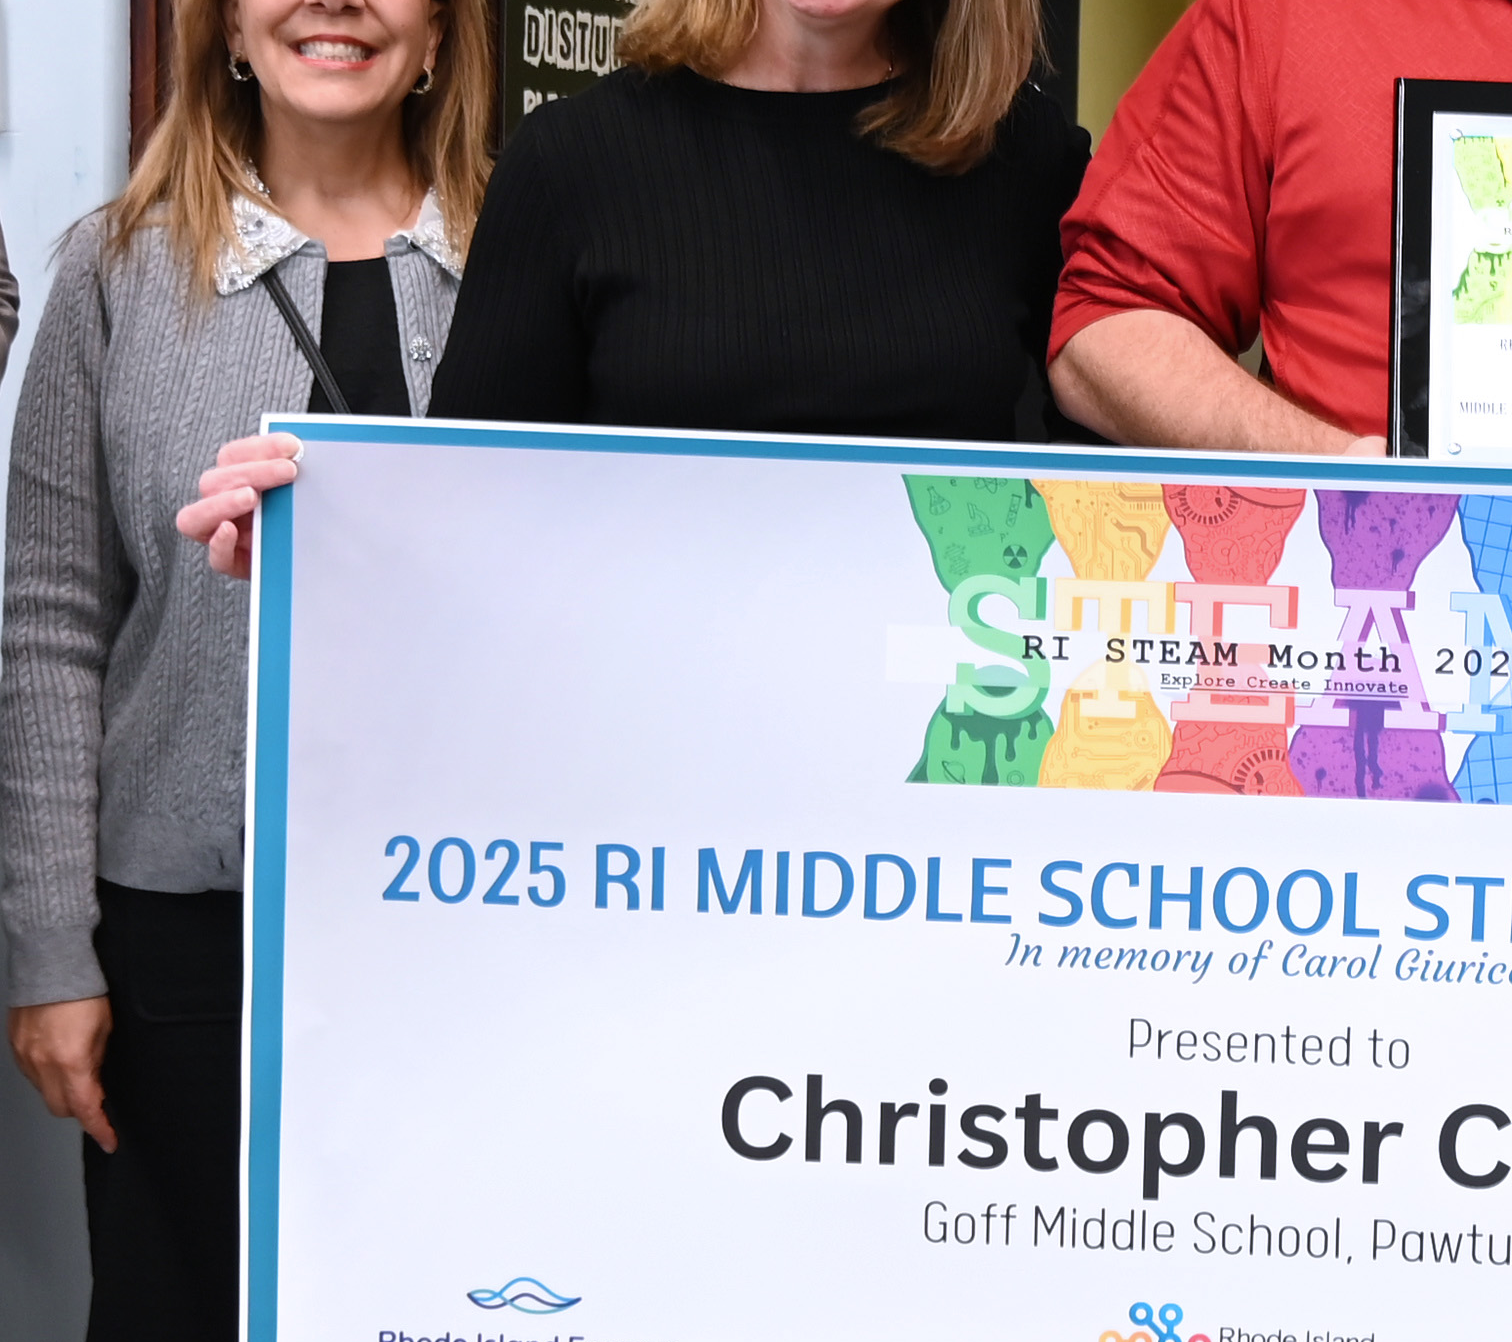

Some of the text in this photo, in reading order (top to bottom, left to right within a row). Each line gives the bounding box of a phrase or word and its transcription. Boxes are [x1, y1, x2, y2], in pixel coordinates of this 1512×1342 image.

[1459, 401, 1507, 415] MIDDLE
[1020, 635, 1070, 661] RI
[1105, 637, 1239, 669] STEAM
[1267, 641, 1402, 675] Month
[1160, 672, 1410, 696] Explore Create Innovate
[382, 834, 568, 908] 2025
[592, 843, 667, 912] RI
[694, 847, 1014, 927] MIDDLE
[1037, 858, 1379, 939] SCHOOL
[1005, 931, 1044, 970] In
[1057, 943, 1214, 985] memory
[1228, 940, 1274, 981] of
[1281, 943, 1383, 980] Carol
[1129, 1017, 1411, 1069] Presented to
[719, 1072, 1405, 1201] Christopher
[921, 1199, 1018, 1249] Goff
[1032, 1204, 1176, 1256] Middle
[1192, 1210, 1354, 1265] School,
